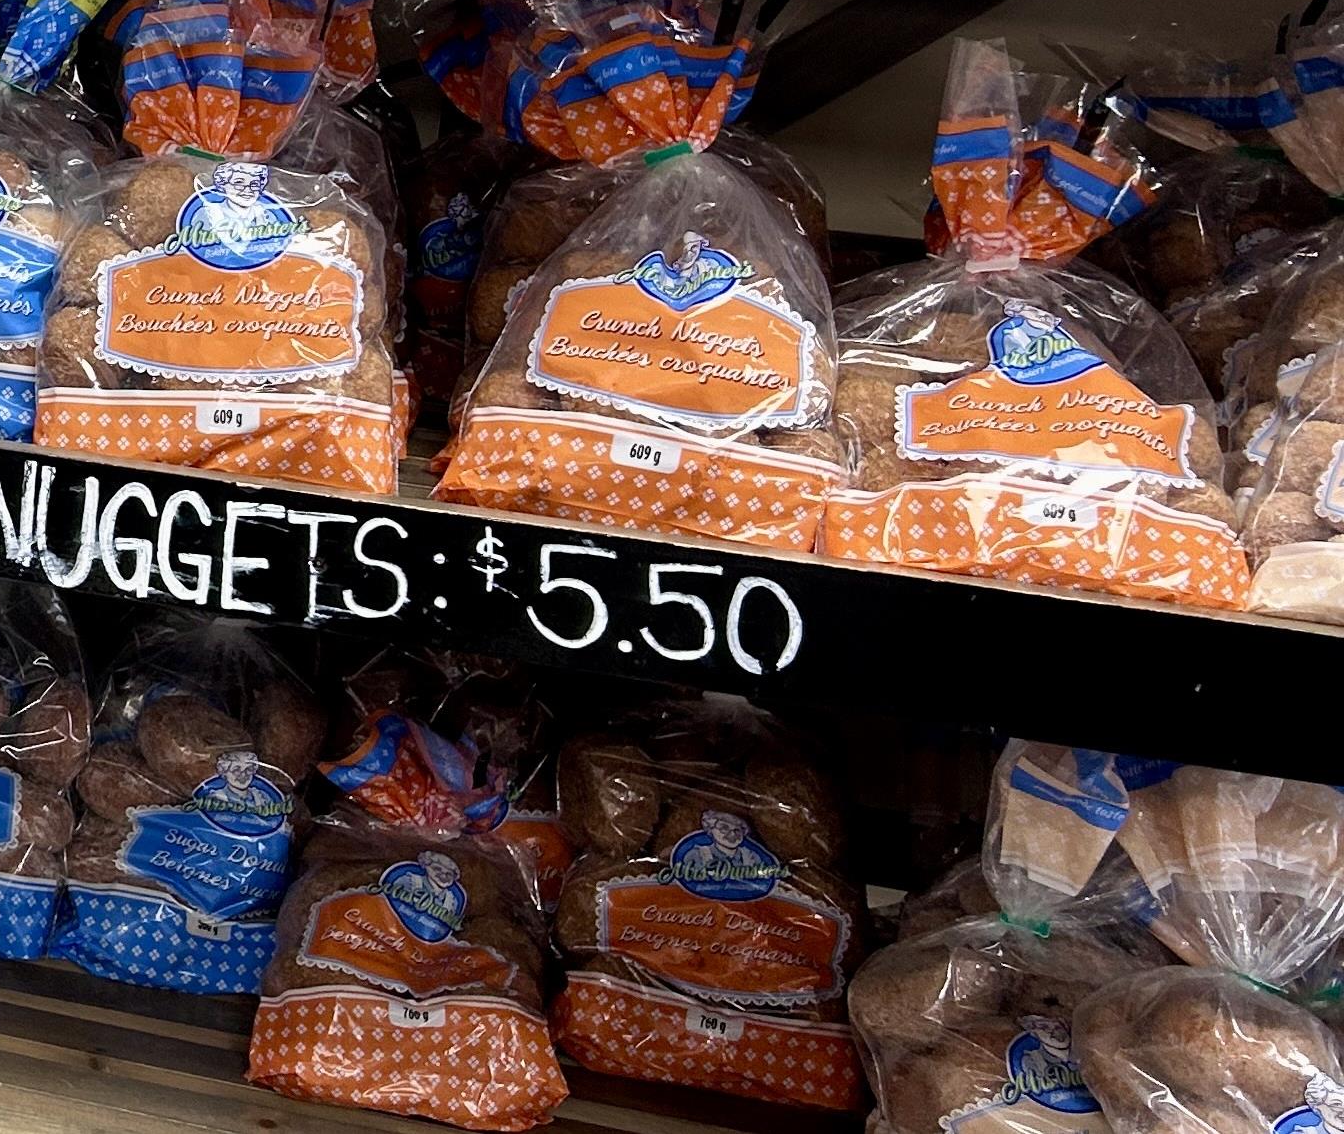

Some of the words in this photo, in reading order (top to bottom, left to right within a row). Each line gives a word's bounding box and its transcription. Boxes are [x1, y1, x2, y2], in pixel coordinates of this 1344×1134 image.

[144, 284, 224, 307] Crunch
[232, 283, 324, 313] Nuggets
[114, 311, 217, 335] Bouchées
[222, 317, 352, 342] croquantes
[578, 310, 662, 340] Crunch
[670, 318, 767, 360] Nuggets
[544, 335, 652, 368] Bouchées
[658, 355, 798, 394] croquantes
[213, 409, 234, 425] 609
[235, 413, 243, 428] g
[947, 392, 1044, 415] Crunch
[1056, 388, 1163, 420] Nuggets
[628, 442, 653, 463] 609
[653, 450, 663, 467] g
[918, 416, 1039, 438] Bouchées
[1048, 418, 1178, 462] croquantes
[1042, 502, 1064, 521] 609
[1065, 507, 1077, 524] g
[474, 525, 804, 676] $5.50
[163, 828, 218, 858] Sugar
[149, 849, 233, 891] Beignes
[343, 907, 408, 952] Crunch
[618, 924, 703, 953] Beignes
[640, 904, 717, 928] Crunch
[724, 912, 802, 942] Donuts
[422, 1010, 430, 1023] g
[699, 1014, 718, 1031] 760
[718, 1020, 728, 1034] g
